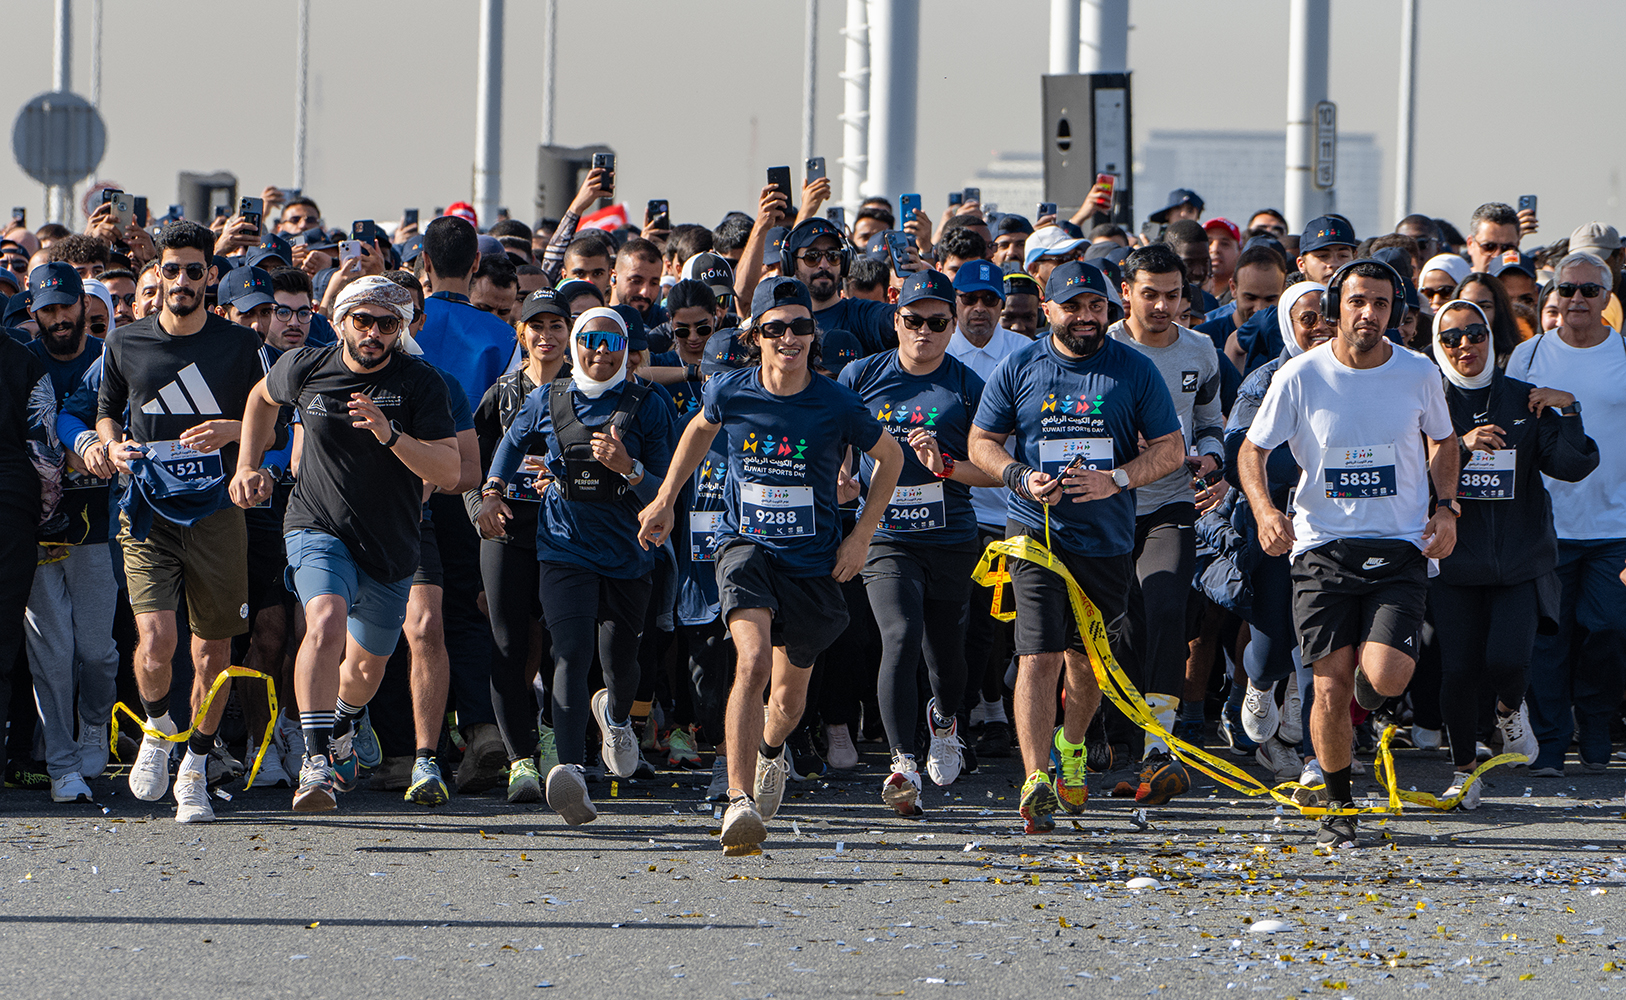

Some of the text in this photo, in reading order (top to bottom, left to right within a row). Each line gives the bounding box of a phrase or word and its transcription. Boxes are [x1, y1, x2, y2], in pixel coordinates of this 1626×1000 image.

[167, 461, 204, 476] 1521
[744, 465, 767, 473] KUWAIT
[768, 468, 793, 476] SPORTS
[1340, 471, 1381, 486] 5835
[1461, 473, 1501, 487] 3896
[755, 509, 797, 525] 9288
[890, 507, 930, 520] 2460
[1366, 557, 1385, 565] NIKE
